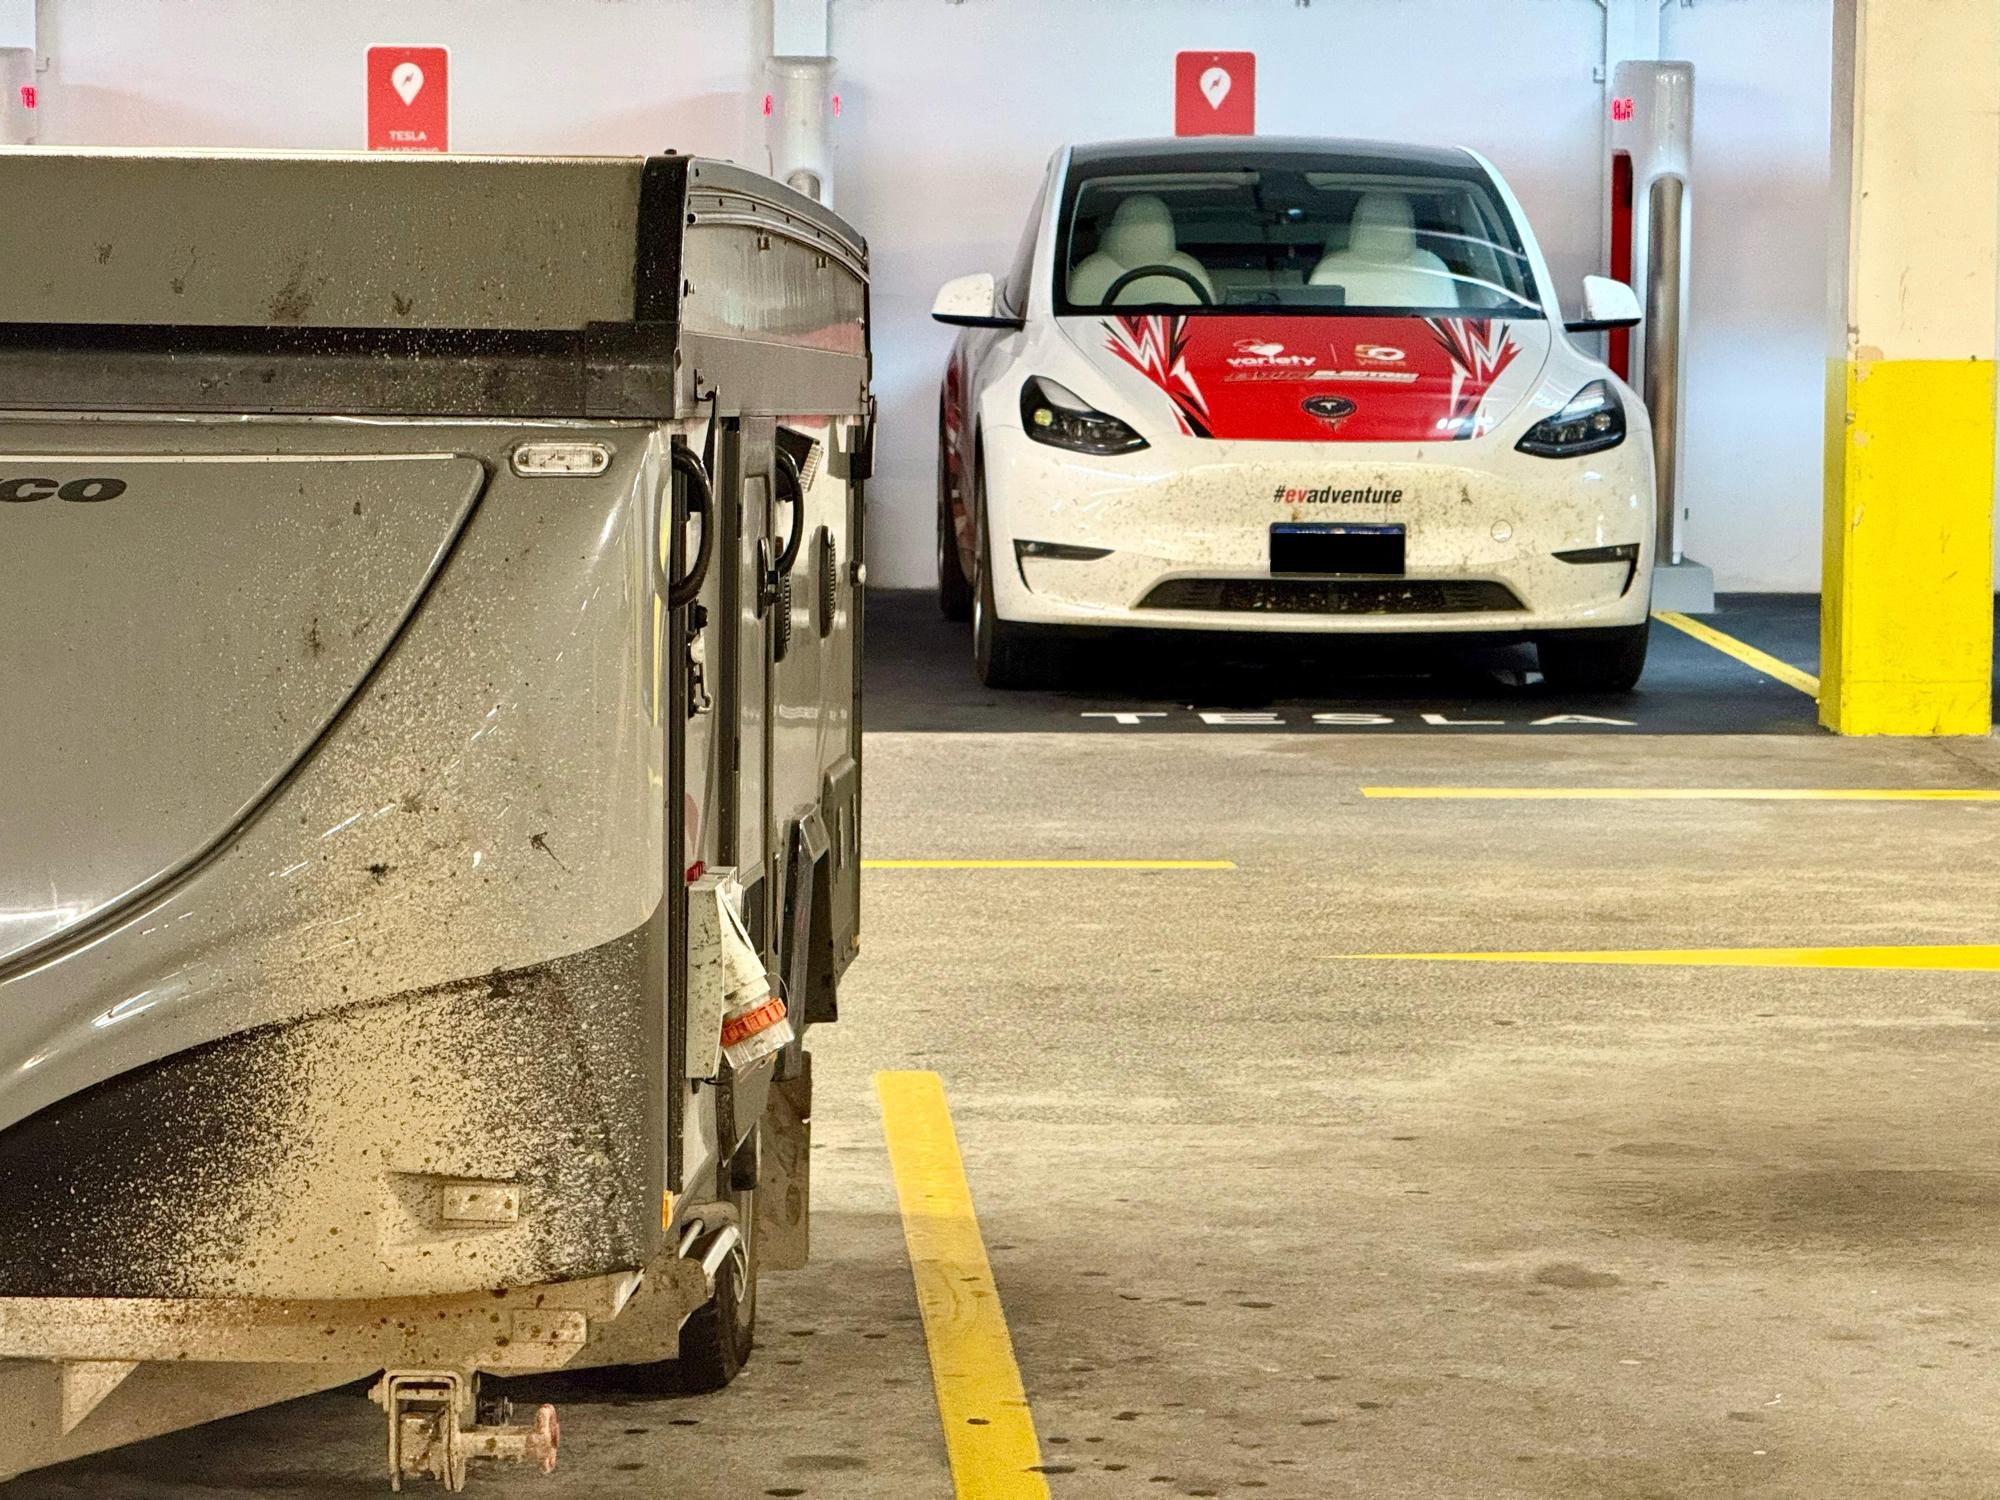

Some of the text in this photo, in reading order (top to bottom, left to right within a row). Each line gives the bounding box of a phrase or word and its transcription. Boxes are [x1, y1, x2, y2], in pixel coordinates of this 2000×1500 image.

[389, 130, 427, 141] TESLA
[1226, 355, 1316, 367] variety
[1273, 485, 1403, 504] #evadventure
[1080, 712, 1637, 725] TESLA
